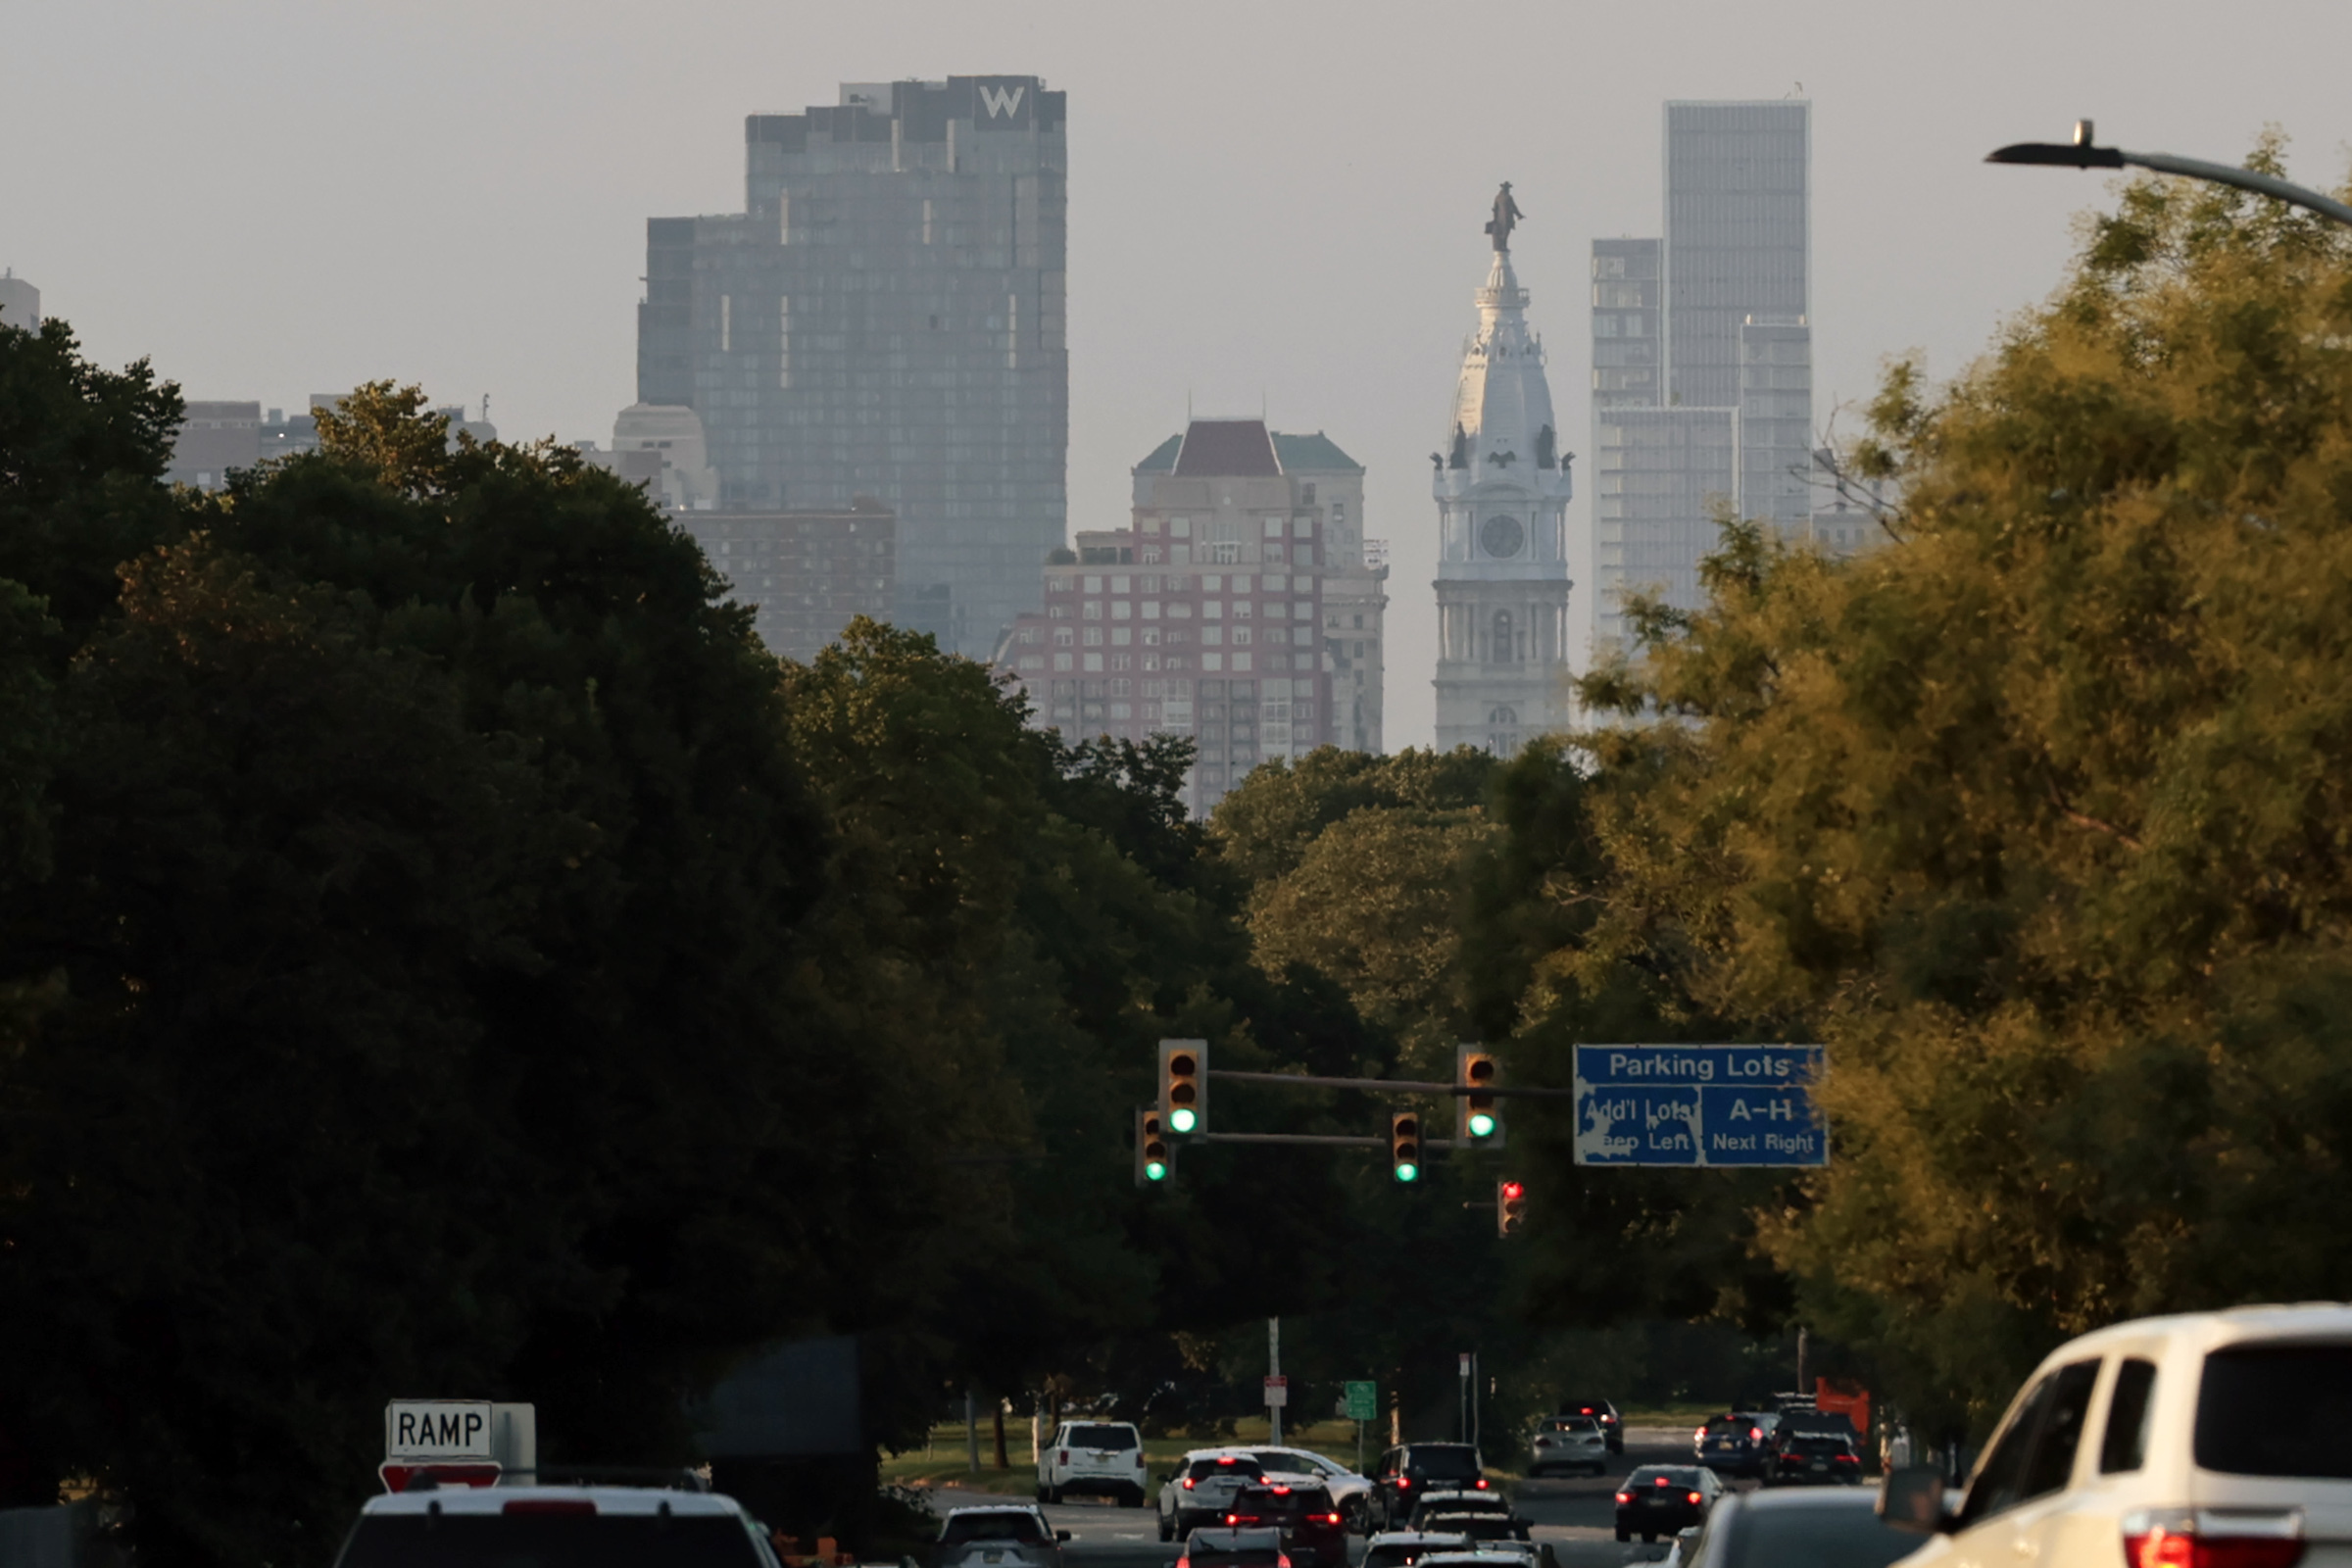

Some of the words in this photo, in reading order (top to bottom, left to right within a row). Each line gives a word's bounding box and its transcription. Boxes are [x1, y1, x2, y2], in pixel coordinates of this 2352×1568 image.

[979, 85, 1025, 120] W
[1609, 1054, 1714, 1081] Parking
[1728, 1054, 1790, 1077] Lots
[1645, 1100, 1692, 1121] Lots
[1729, 1099, 1792, 1121] A-H
[1596, 1134, 1640, 1152] eep
[1713, 1133, 1757, 1151] Next
[1765, 1133, 1815, 1154] Right
[398, 1412, 483, 1447] RAMP
